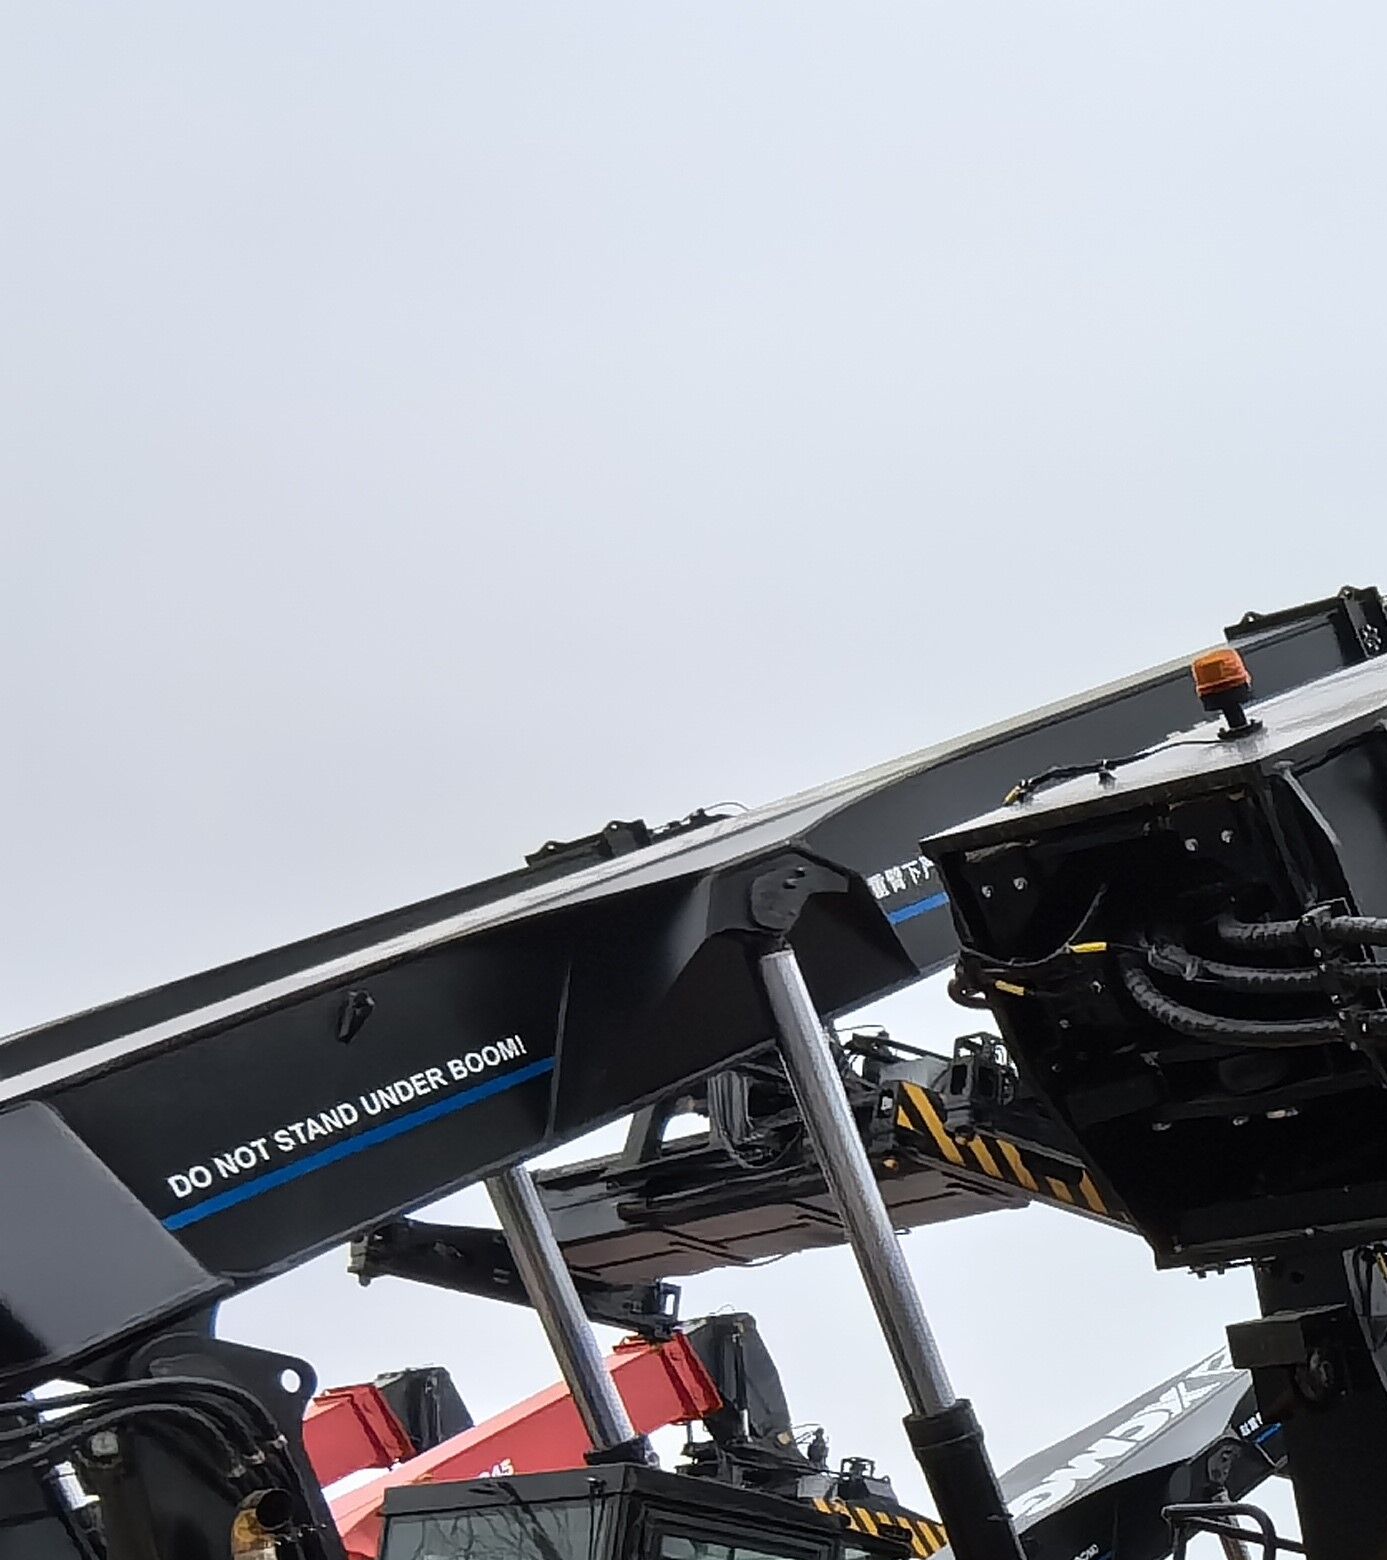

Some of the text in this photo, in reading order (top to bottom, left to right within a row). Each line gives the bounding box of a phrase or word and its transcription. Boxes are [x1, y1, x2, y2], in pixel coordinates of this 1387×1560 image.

[167, 1034, 527, 1198] DO NOT STAND UNDER BOOM!
